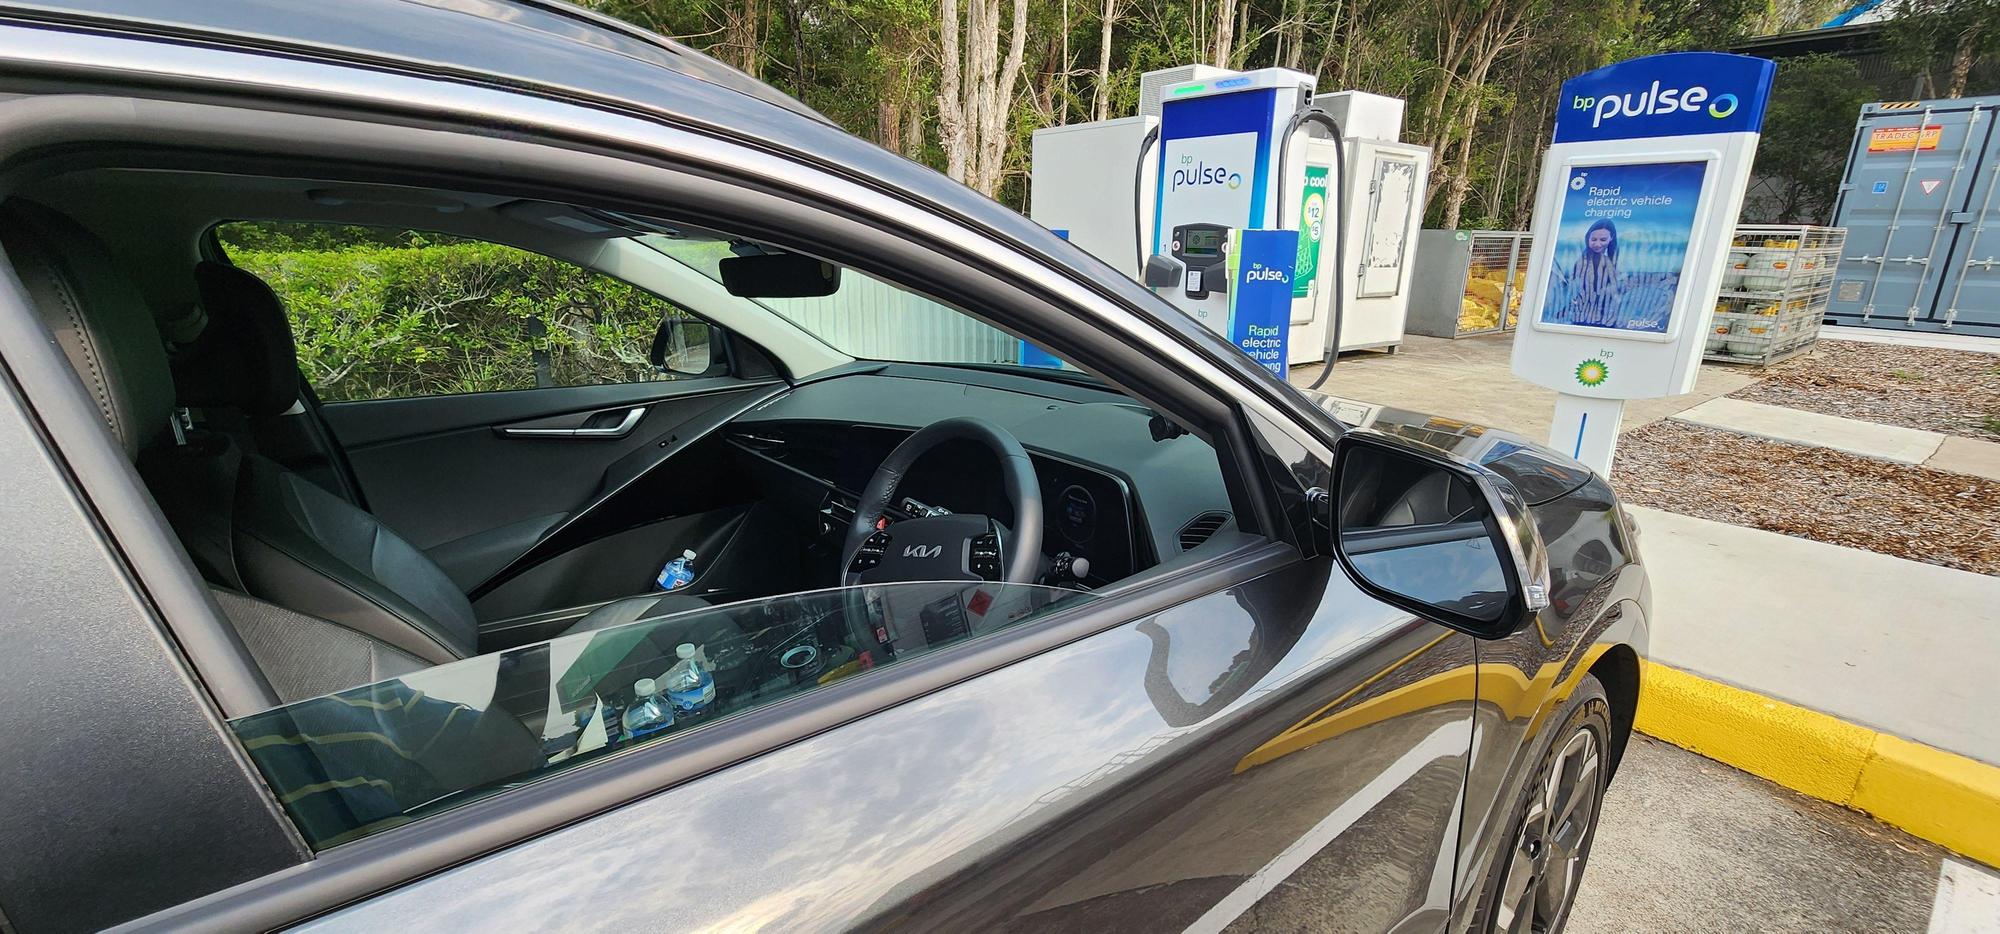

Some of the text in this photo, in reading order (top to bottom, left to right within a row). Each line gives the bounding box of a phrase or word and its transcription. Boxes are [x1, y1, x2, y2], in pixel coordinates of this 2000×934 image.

[1573, 80, 1708, 128] bp pulse
[1181, 153, 1193, 166] bp
[1172, 160, 1227, 192] pulse
[1589, 186, 1621, 197] Rapid
[1586, 195, 1672, 206] electric vehicle
[1584, 208, 1632, 218] charging
[1253, 262, 1262, 270] bp
[1246, 267, 1283, 283] pulse
[1198, 309, 1208, 318] bp
[1627, 318, 1659, 329] pulse
[1248, 324, 1279, 338] Rapid
[1242, 337, 1281, 348] electric
[1246, 349, 1280, 360] ehicle
[1600, 349, 1614, 358] bp
